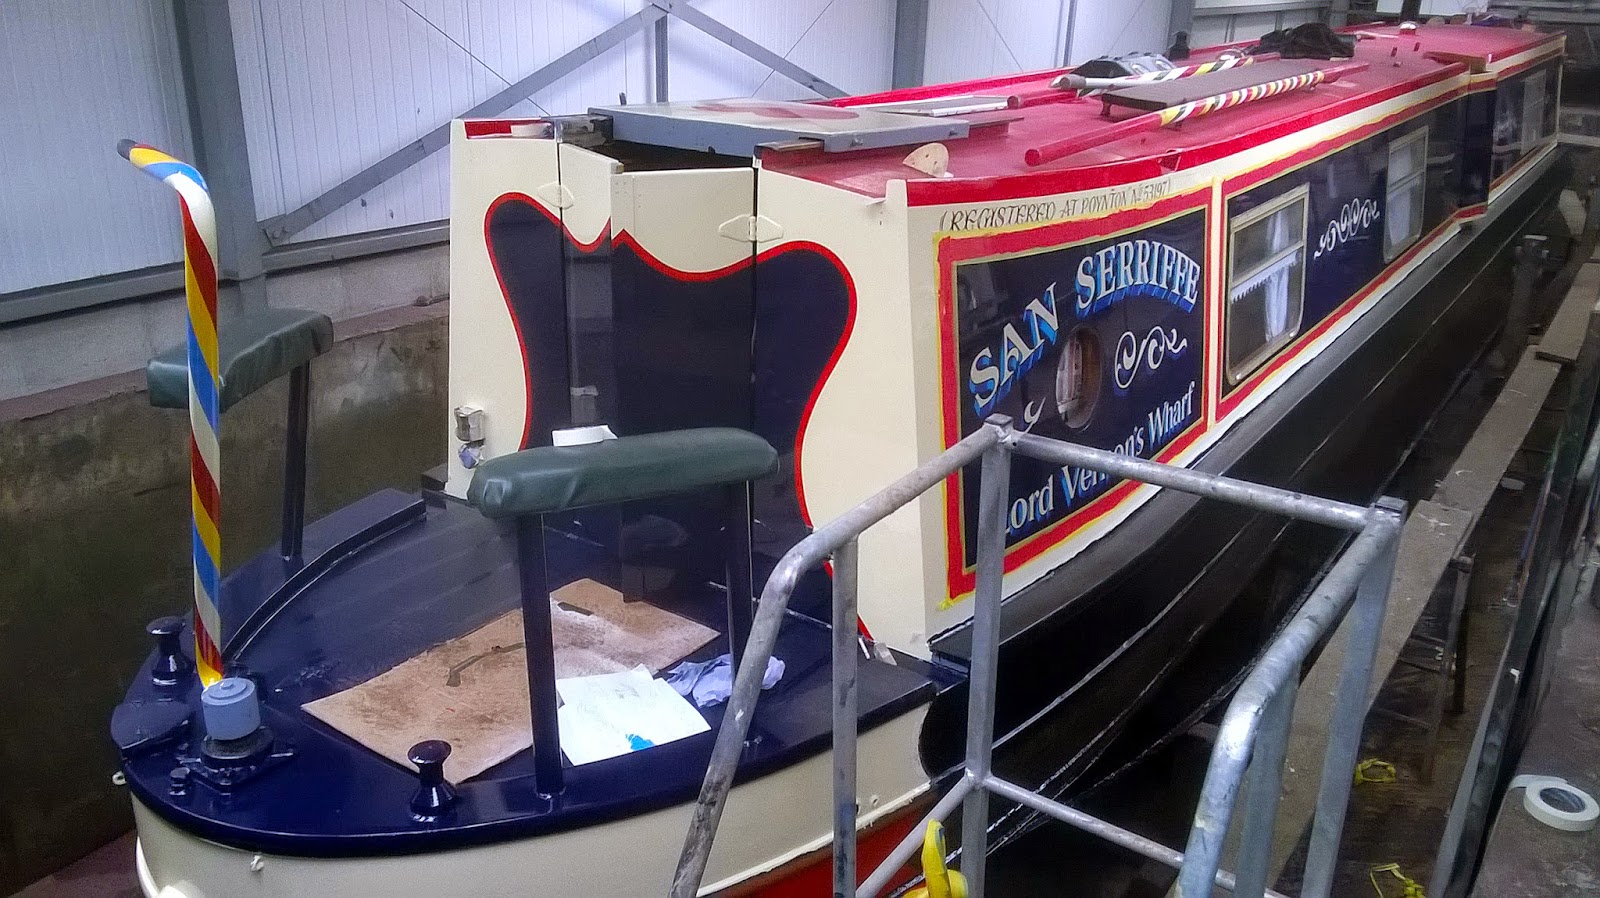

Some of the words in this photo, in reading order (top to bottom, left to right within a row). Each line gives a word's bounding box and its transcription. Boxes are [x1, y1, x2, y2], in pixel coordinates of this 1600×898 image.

[1061, 201, 1078, 217] AT
[1081, 191, 1127, 214] POYNTON
[969, 281, 1060, 411] SAN
[1076, 239, 1201, 313] SERRIFFE
[1006, 474, 1054, 534] ord
[1148, 381, 1195, 443] Wharf
